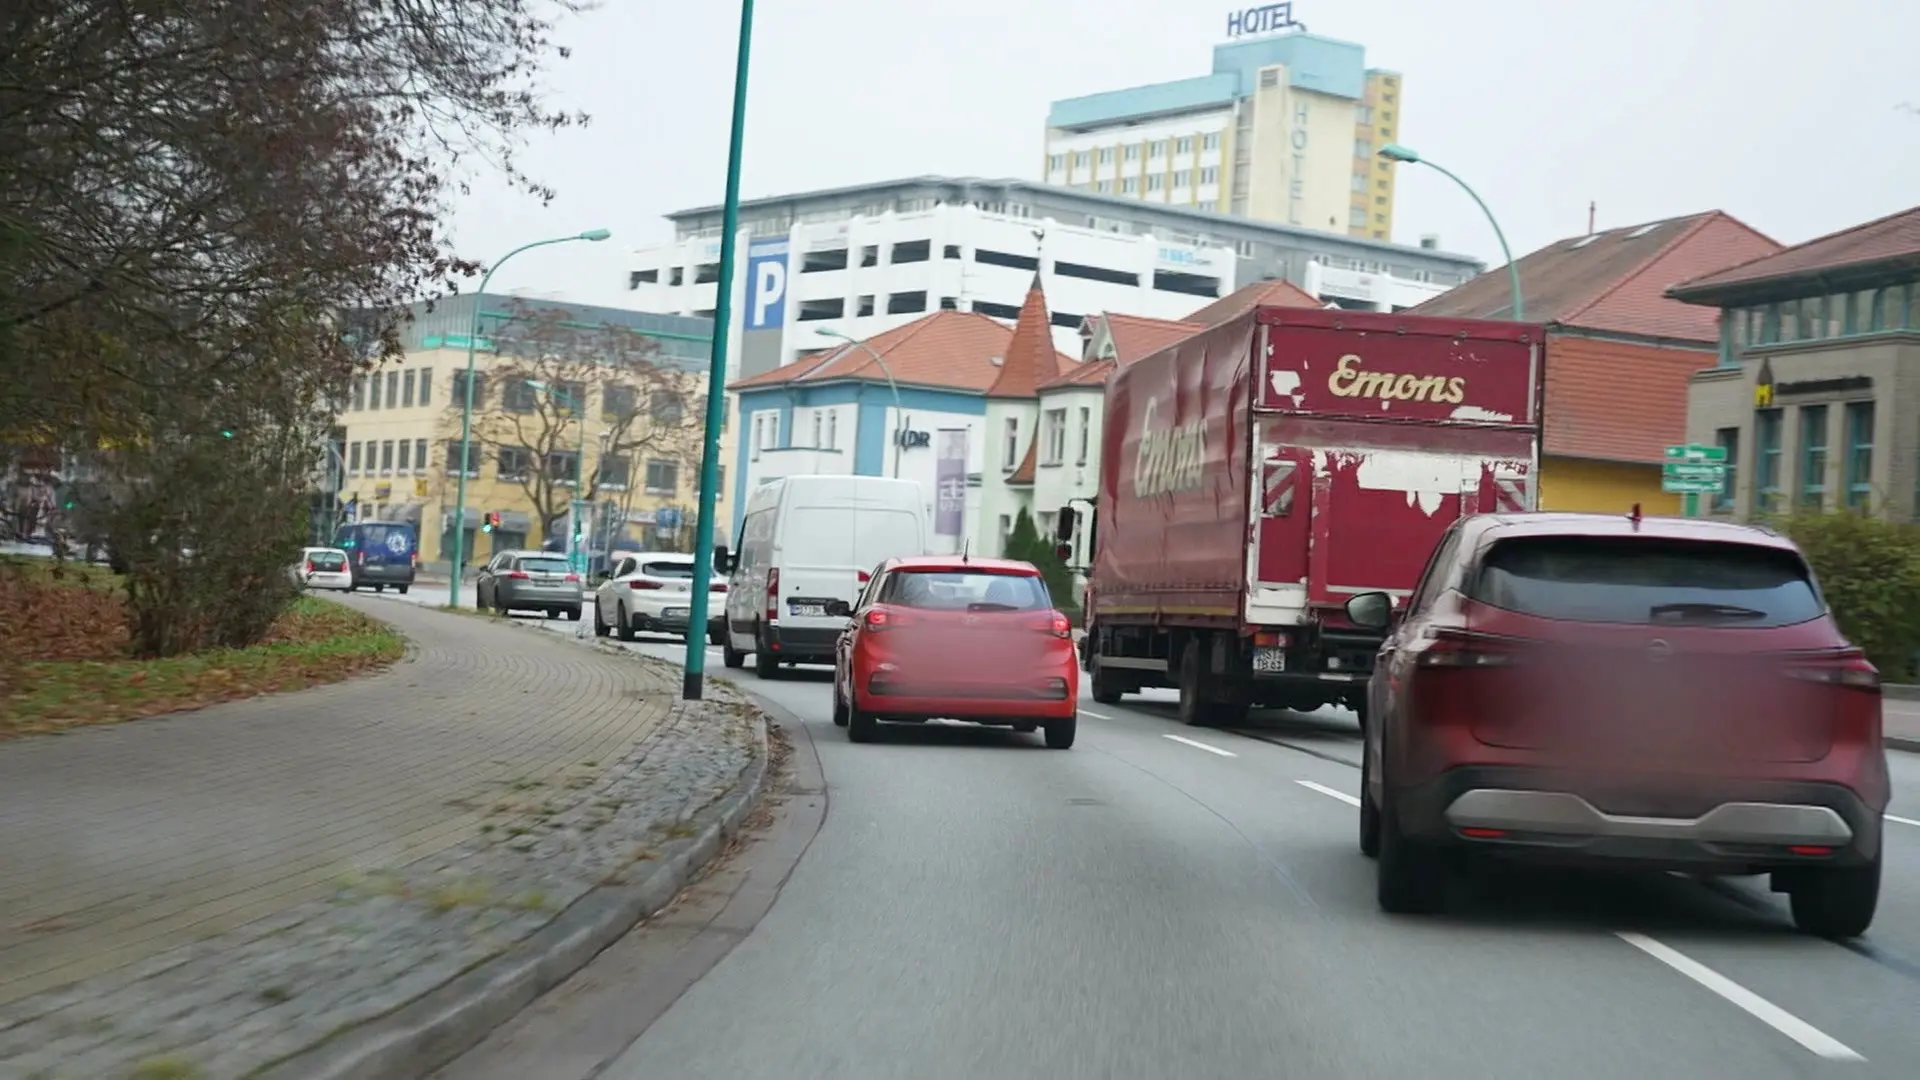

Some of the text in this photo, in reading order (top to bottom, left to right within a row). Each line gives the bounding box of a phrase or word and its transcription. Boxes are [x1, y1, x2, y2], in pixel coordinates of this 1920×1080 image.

[1227, 2, 1297, 36] HOTEL
[753, 261, 785, 326] P
[1328, 354, 1466, 404] Emons
